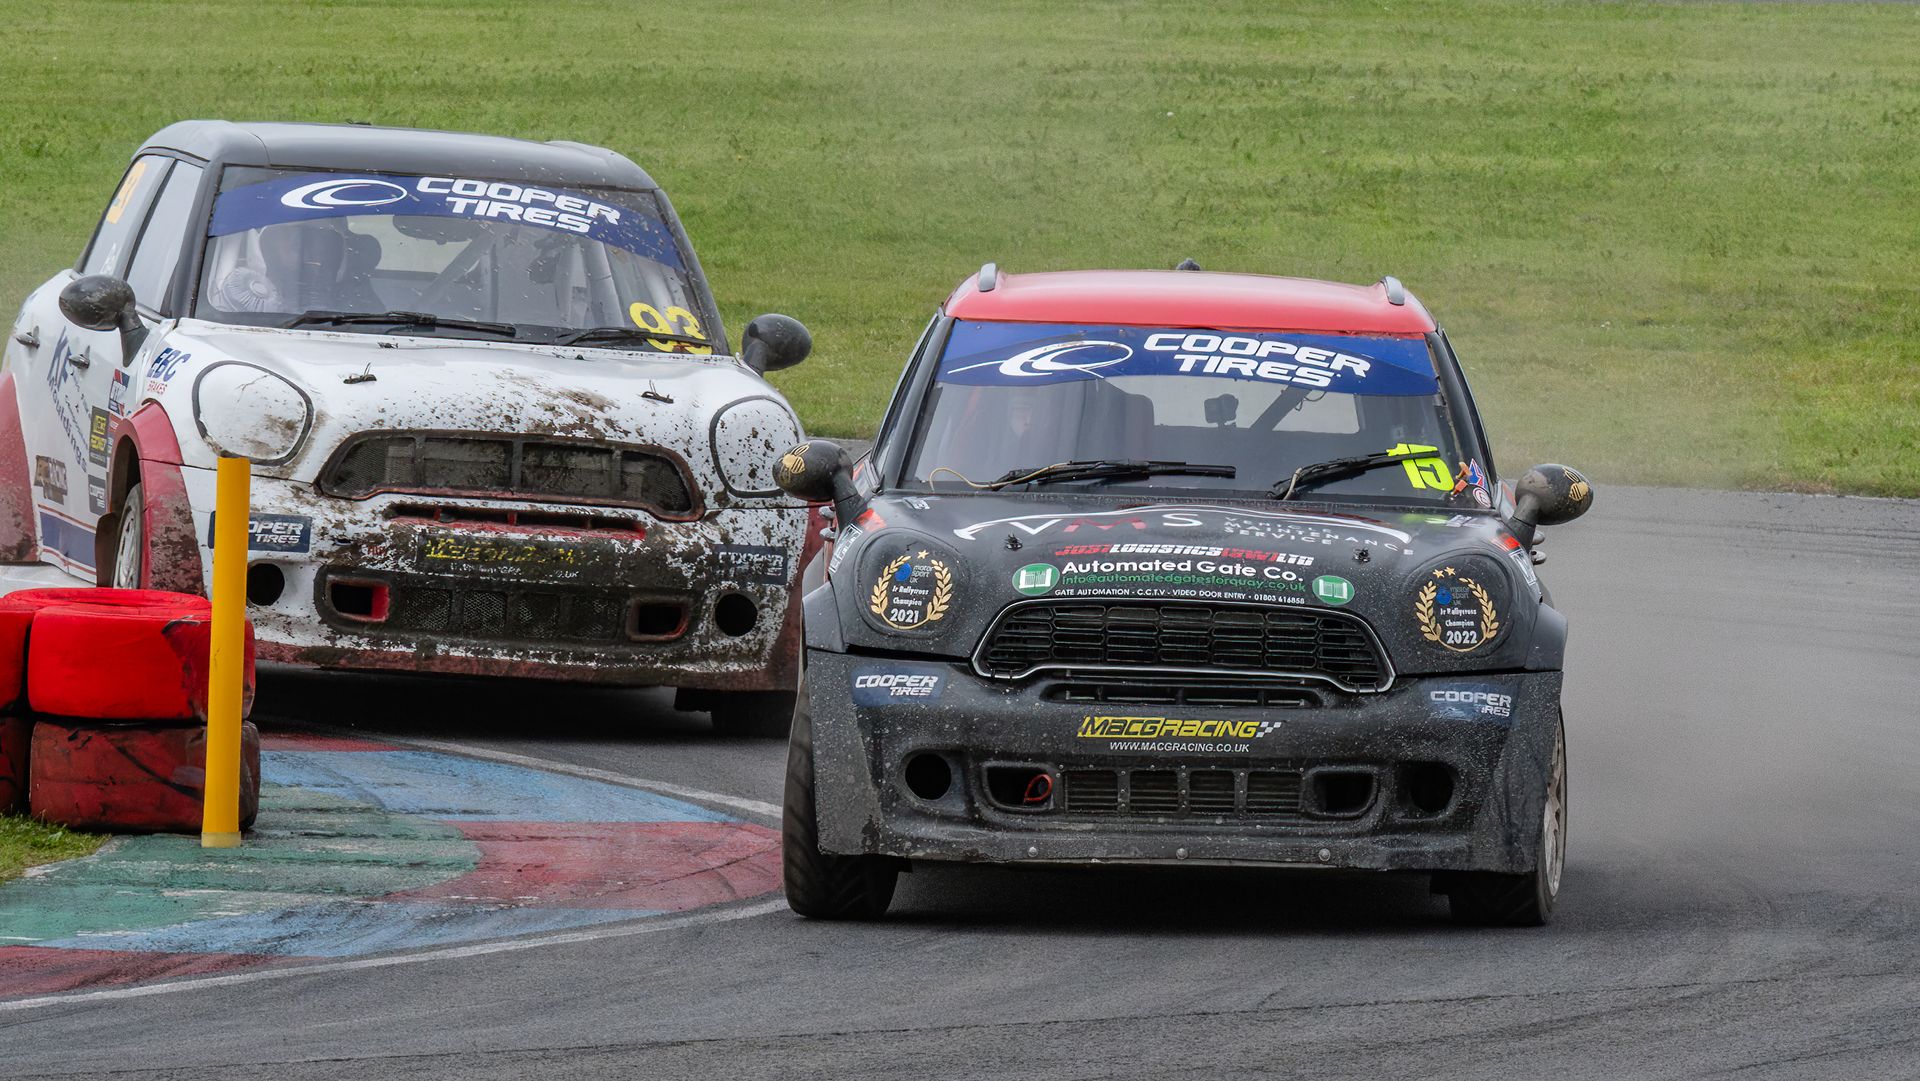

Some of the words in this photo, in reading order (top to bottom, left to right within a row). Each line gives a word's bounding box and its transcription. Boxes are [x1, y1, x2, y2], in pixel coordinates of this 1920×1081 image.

[416, 176, 620, 225] COOPER
[446, 196, 592, 233] TIRES
[629, 302, 713, 355] 93
[1144, 333, 1371, 378] COOPER
[147, 347, 191, 382] EBC
[1173, 353, 1334, 388] TIRES
[1386, 443, 1454, 491] 15
[248, 520, 304, 535] OPER
[1008, 513, 1203, 535] VMS
[255, 533, 301, 544] TIRES
[1224, 526, 1332, 545] SERVICE
[1224, 521, 1414, 556] MAINTENANCE
[911, 570, 931, 579] sport
[913, 565, 934, 573] motor
[1062, 559, 1191, 574] Automated
[1197, 560, 1257, 577] Gate
[1263, 566, 1304, 582] Co.
[898, 586, 929, 596] Rallycross
[1172, 589, 1197, 597] VIDEO
[1199, 590, 1222, 598] DOOR
[1223, 592, 1246, 600] ENTRY
[1254, 594, 1277, 602] 01803
[893, 597, 922, 607] Champion
[890, 608, 919, 623] 2021
[1445, 619, 1475, 628] Champion
[1446, 630, 1478, 644] 2022
[855, 674, 939, 689] COOPER
[889, 686, 932, 697] TIRES
[1430, 690, 1512, 708] COOPER
[1109, 741, 1250, 753] WWW.MACGRACING.CO.UK
